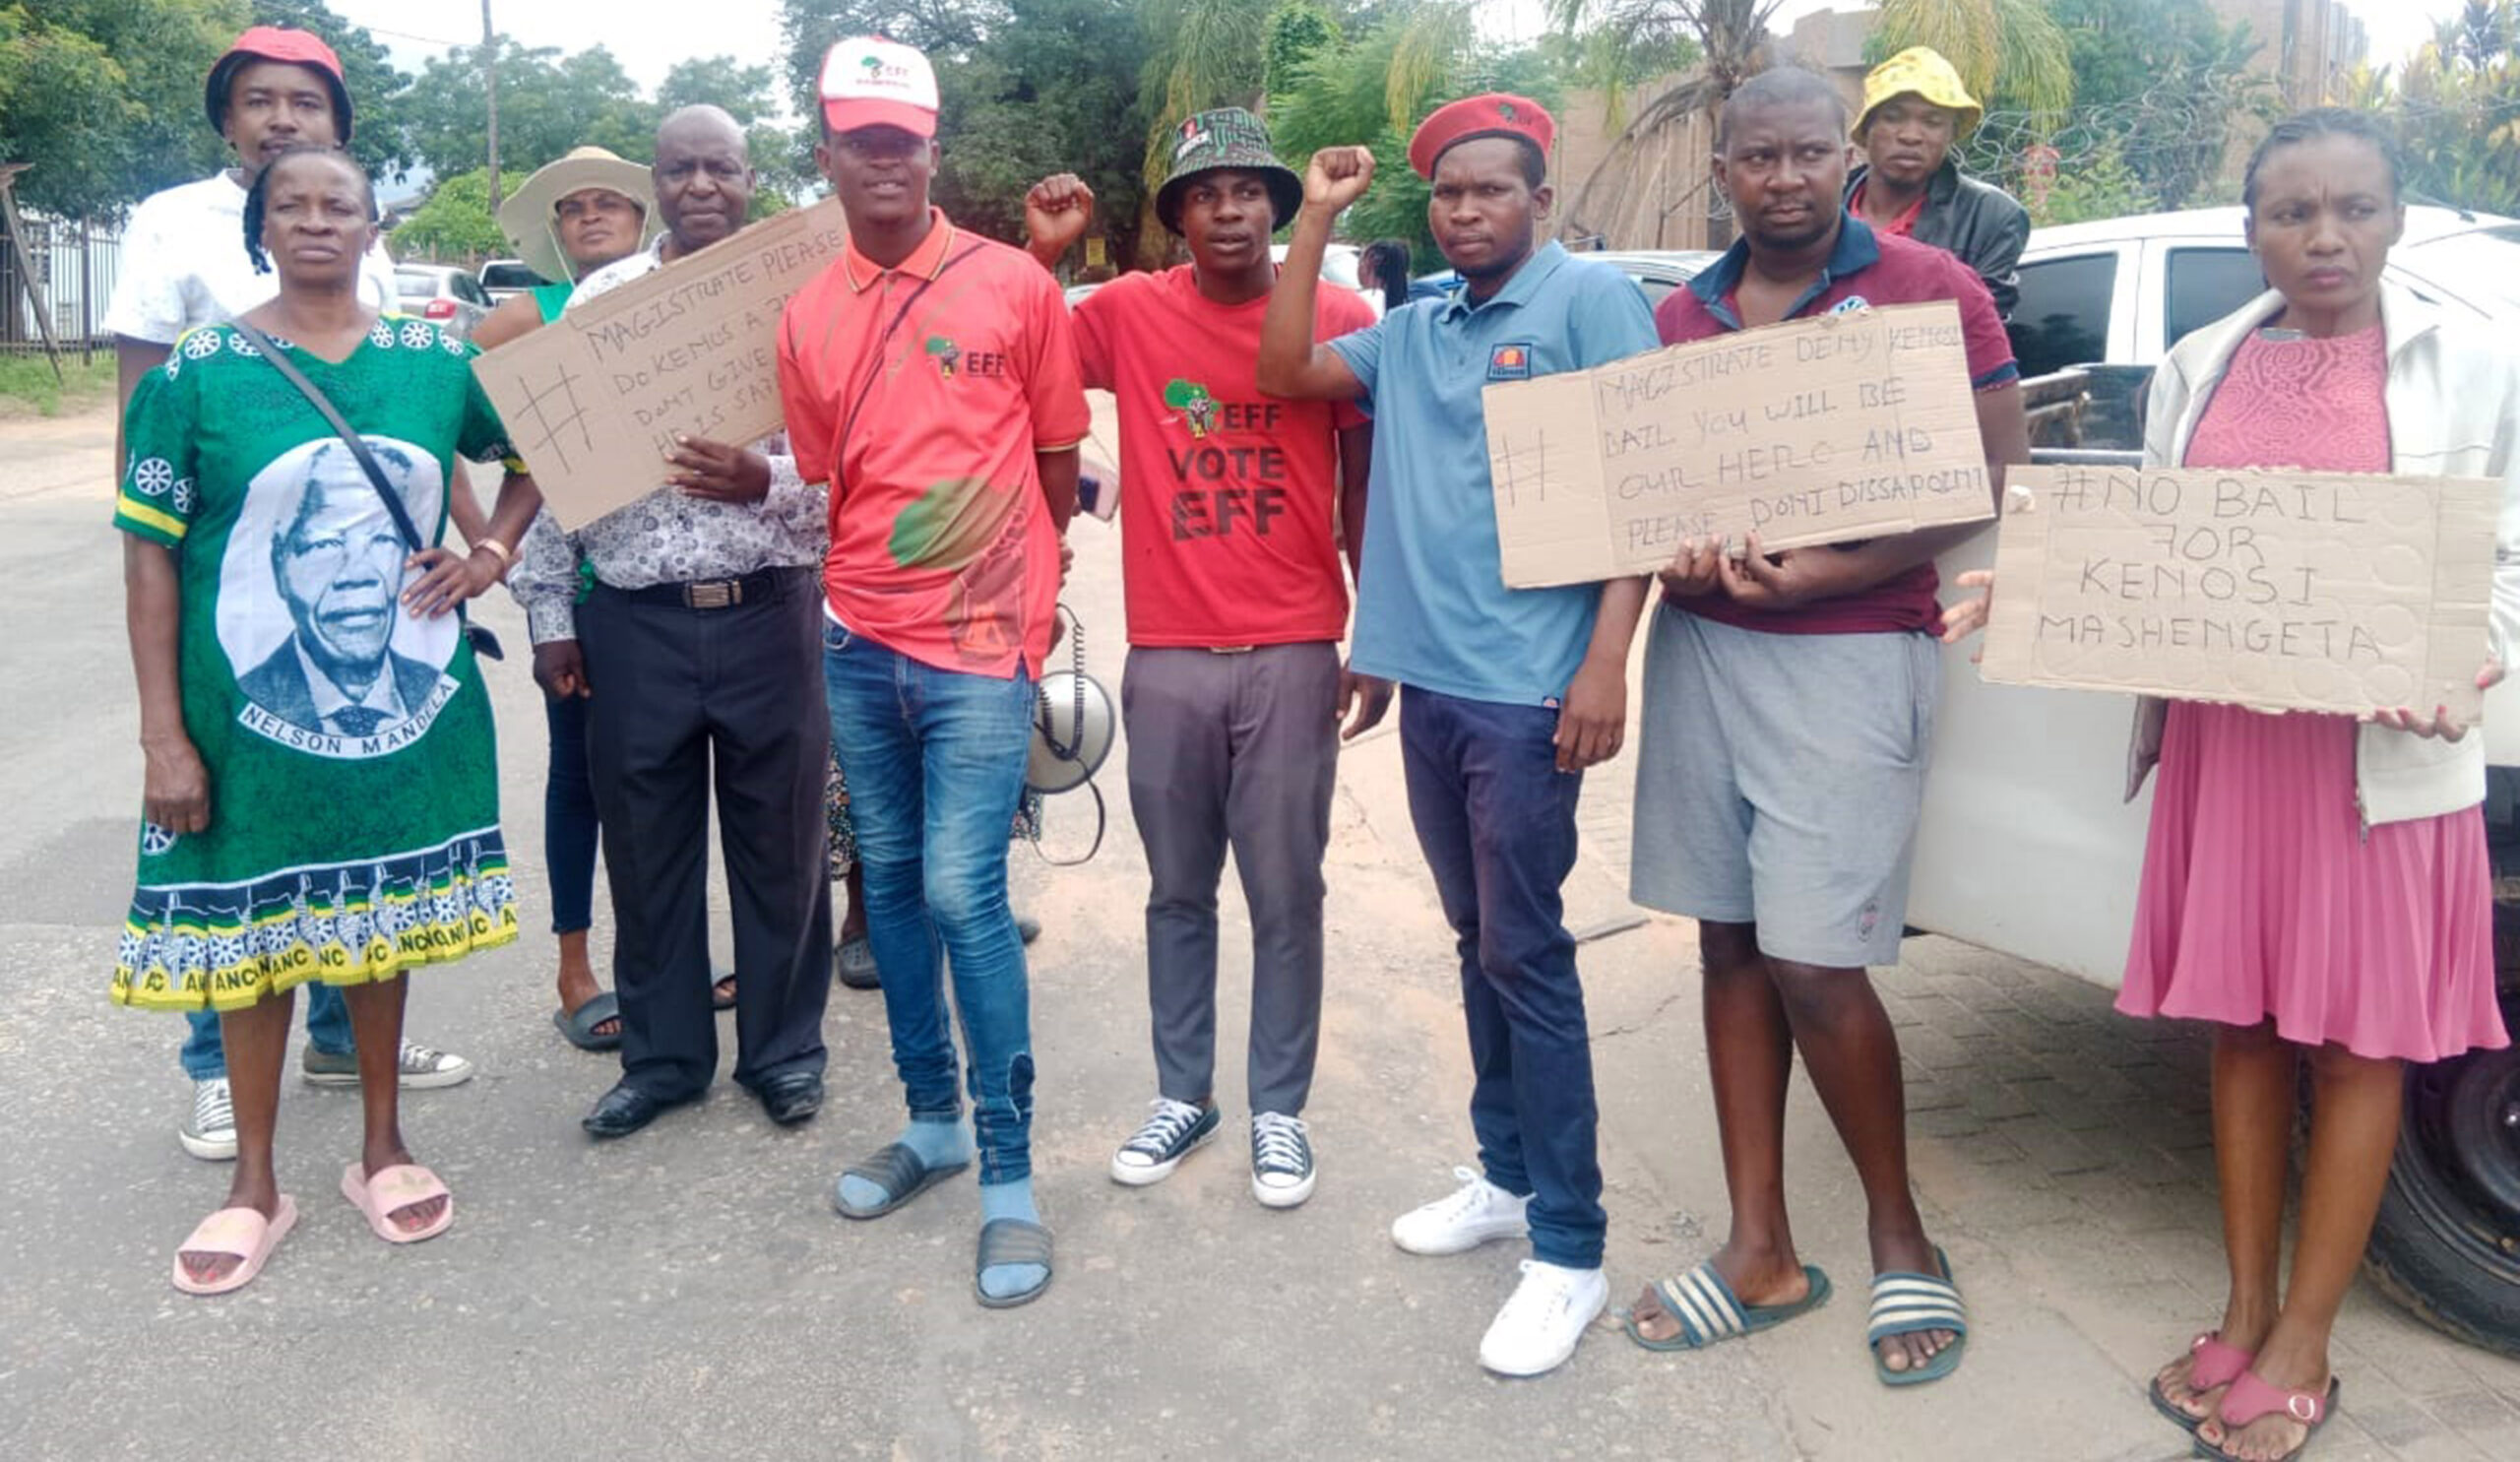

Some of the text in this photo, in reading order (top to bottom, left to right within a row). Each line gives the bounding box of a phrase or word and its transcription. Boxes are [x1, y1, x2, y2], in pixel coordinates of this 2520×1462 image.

[588, 264, 755, 363] MAGISTRATE
[745, 311, 764, 329] A
[708, 348, 769, 391] GIVE
[966, 351, 1007, 373] EFF
[1600, 345, 1772, 413] MAGISTRATE
[1224, 404, 1283, 430] EFF
[1764, 390, 1838, 421] WILL
[1859, 377, 1907, 409] BE
[1166, 446, 1286, 482] VOTE
[1618, 426, 1933, 501] OUR HERO AND
[1171, 487, 1287, 540] EFF
[2214, 477, 2366, 524] BAIL
[1627, 511, 1718, 551] PLEASE
[2080, 556, 2319, 607] KENOSI
[243, 682, 453, 754] NELSON MANDELA
[216, 968, 257, 990] ANC
[272, 948, 308, 976] ANC
